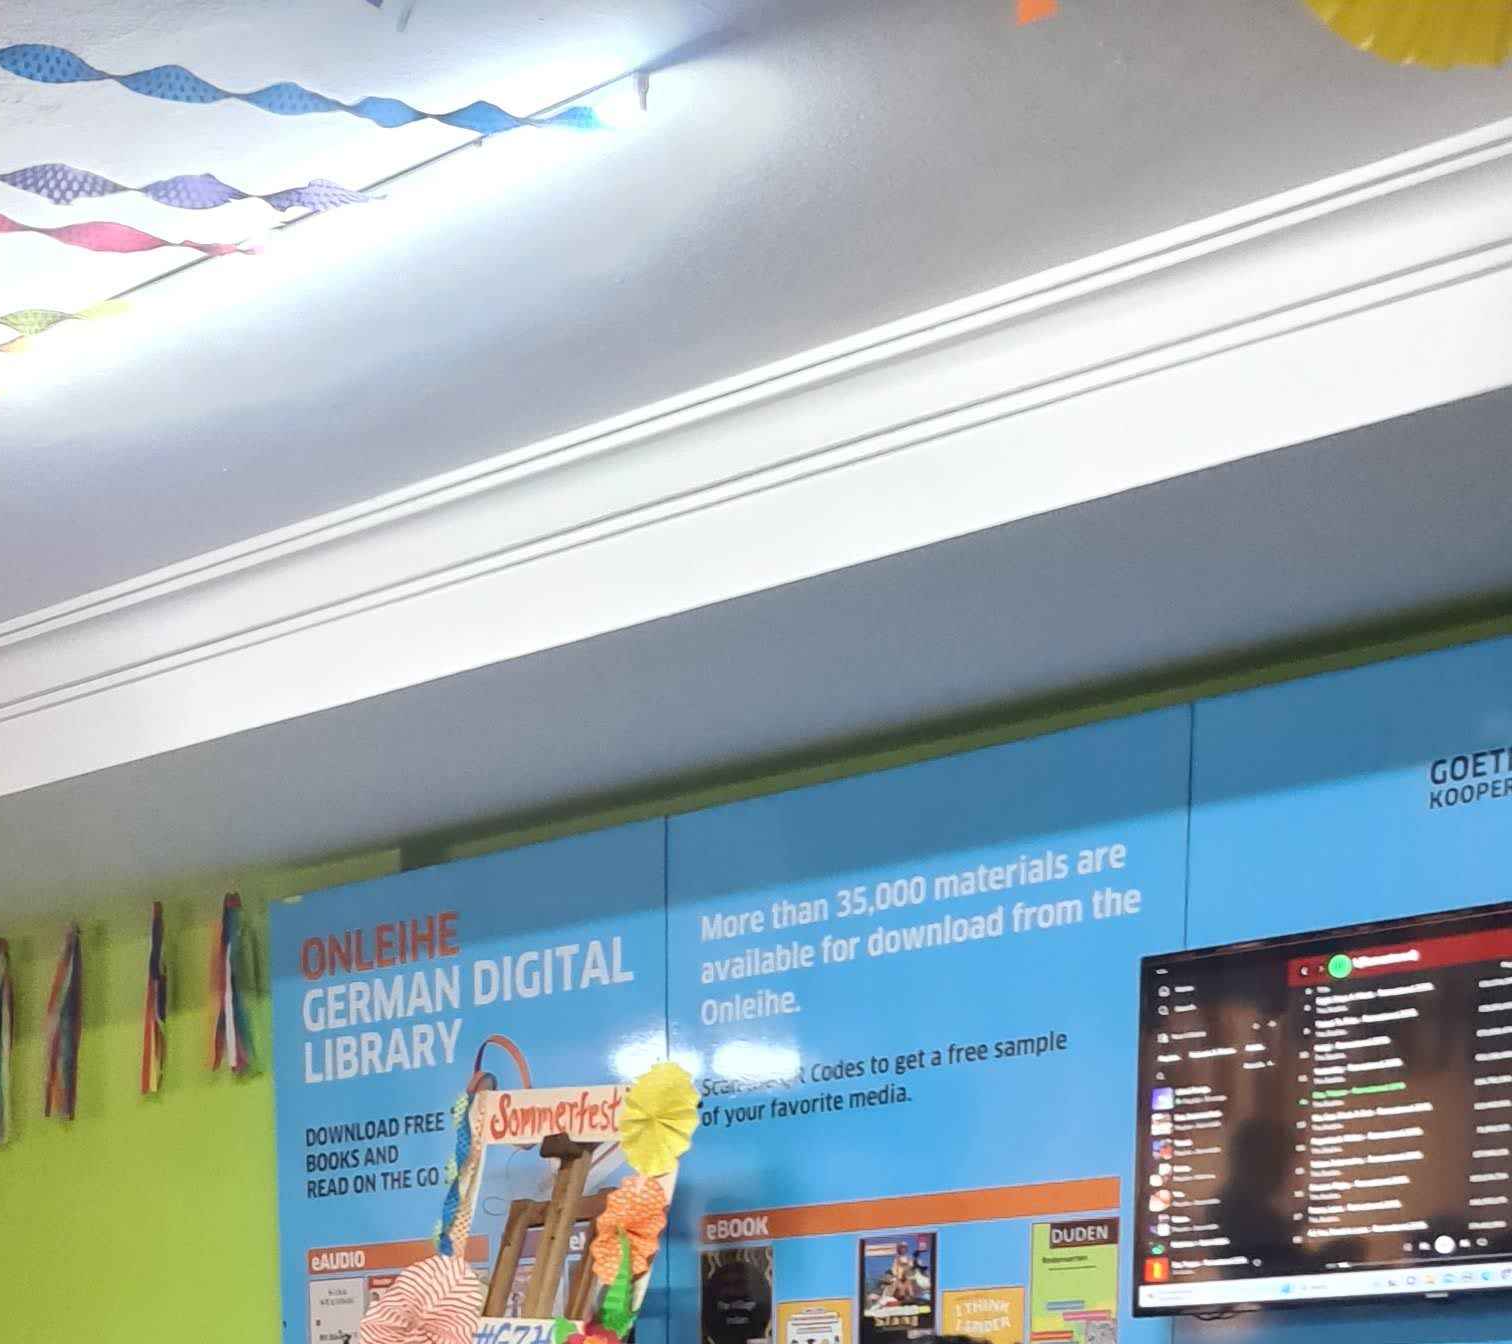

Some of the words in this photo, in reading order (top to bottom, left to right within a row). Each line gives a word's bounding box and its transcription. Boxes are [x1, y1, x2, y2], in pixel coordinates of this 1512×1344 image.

[700, 910, 765, 942] More
[772, 898, 829, 930] than
[837, 876, 926, 918] 35,000
[934, 850, 1069, 901] materials
[1077, 843, 1127, 876] are
[300, 910, 461, 981] ONLEIHE
[700, 941, 815, 984] available
[821, 935, 861, 964] for
[867, 904, 1004, 957] download
[1012, 898, 1083, 933] from
[1092, 887, 1142, 920] the
[303, 965, 462, 1033] GERMAN
[473, 936, 635, 1008] DIGITAL
[700, 989, 801, 1026] Onleihe.
[304, 1018, 464, 1084] LIBRARY
[811, 1058, 865, 1083] Codes
[871, 1055, 889, 1075] to
[895, 1049, 926, 1076] get
[931, 1050, 942, 1067] a
[948, 1042, 989, 1065] free
[994, 1030, 1068, 1059] sample
[490, 1086, 622, 1140] Sommerfest
[701, 1105, 721, 1127] of
[724, 1103, 765, 1129] your
[771, 1092, 845, 1119] favorite
[848, 1082, 913, 1109] media.
[306, 1117, 400, 1147] DOWNLOAD
[405, 1112, 445, 1136] FREE
[306, 1148, 360, 1173] BOOKS
[364, 1145, 399, 1167] AND
[307, 1177, 349, 1199] READ
[353, 1173, 376, 1194] ON
[381, 1169, 412, 1191] THE
[416, 1166, 439, 1187] GO
[706, 1214, 769, 1241] eBOOK
[1051, 1225, 1109, 1244] DUDEN
[311, 1250, 366, 1271] eAUDIO
